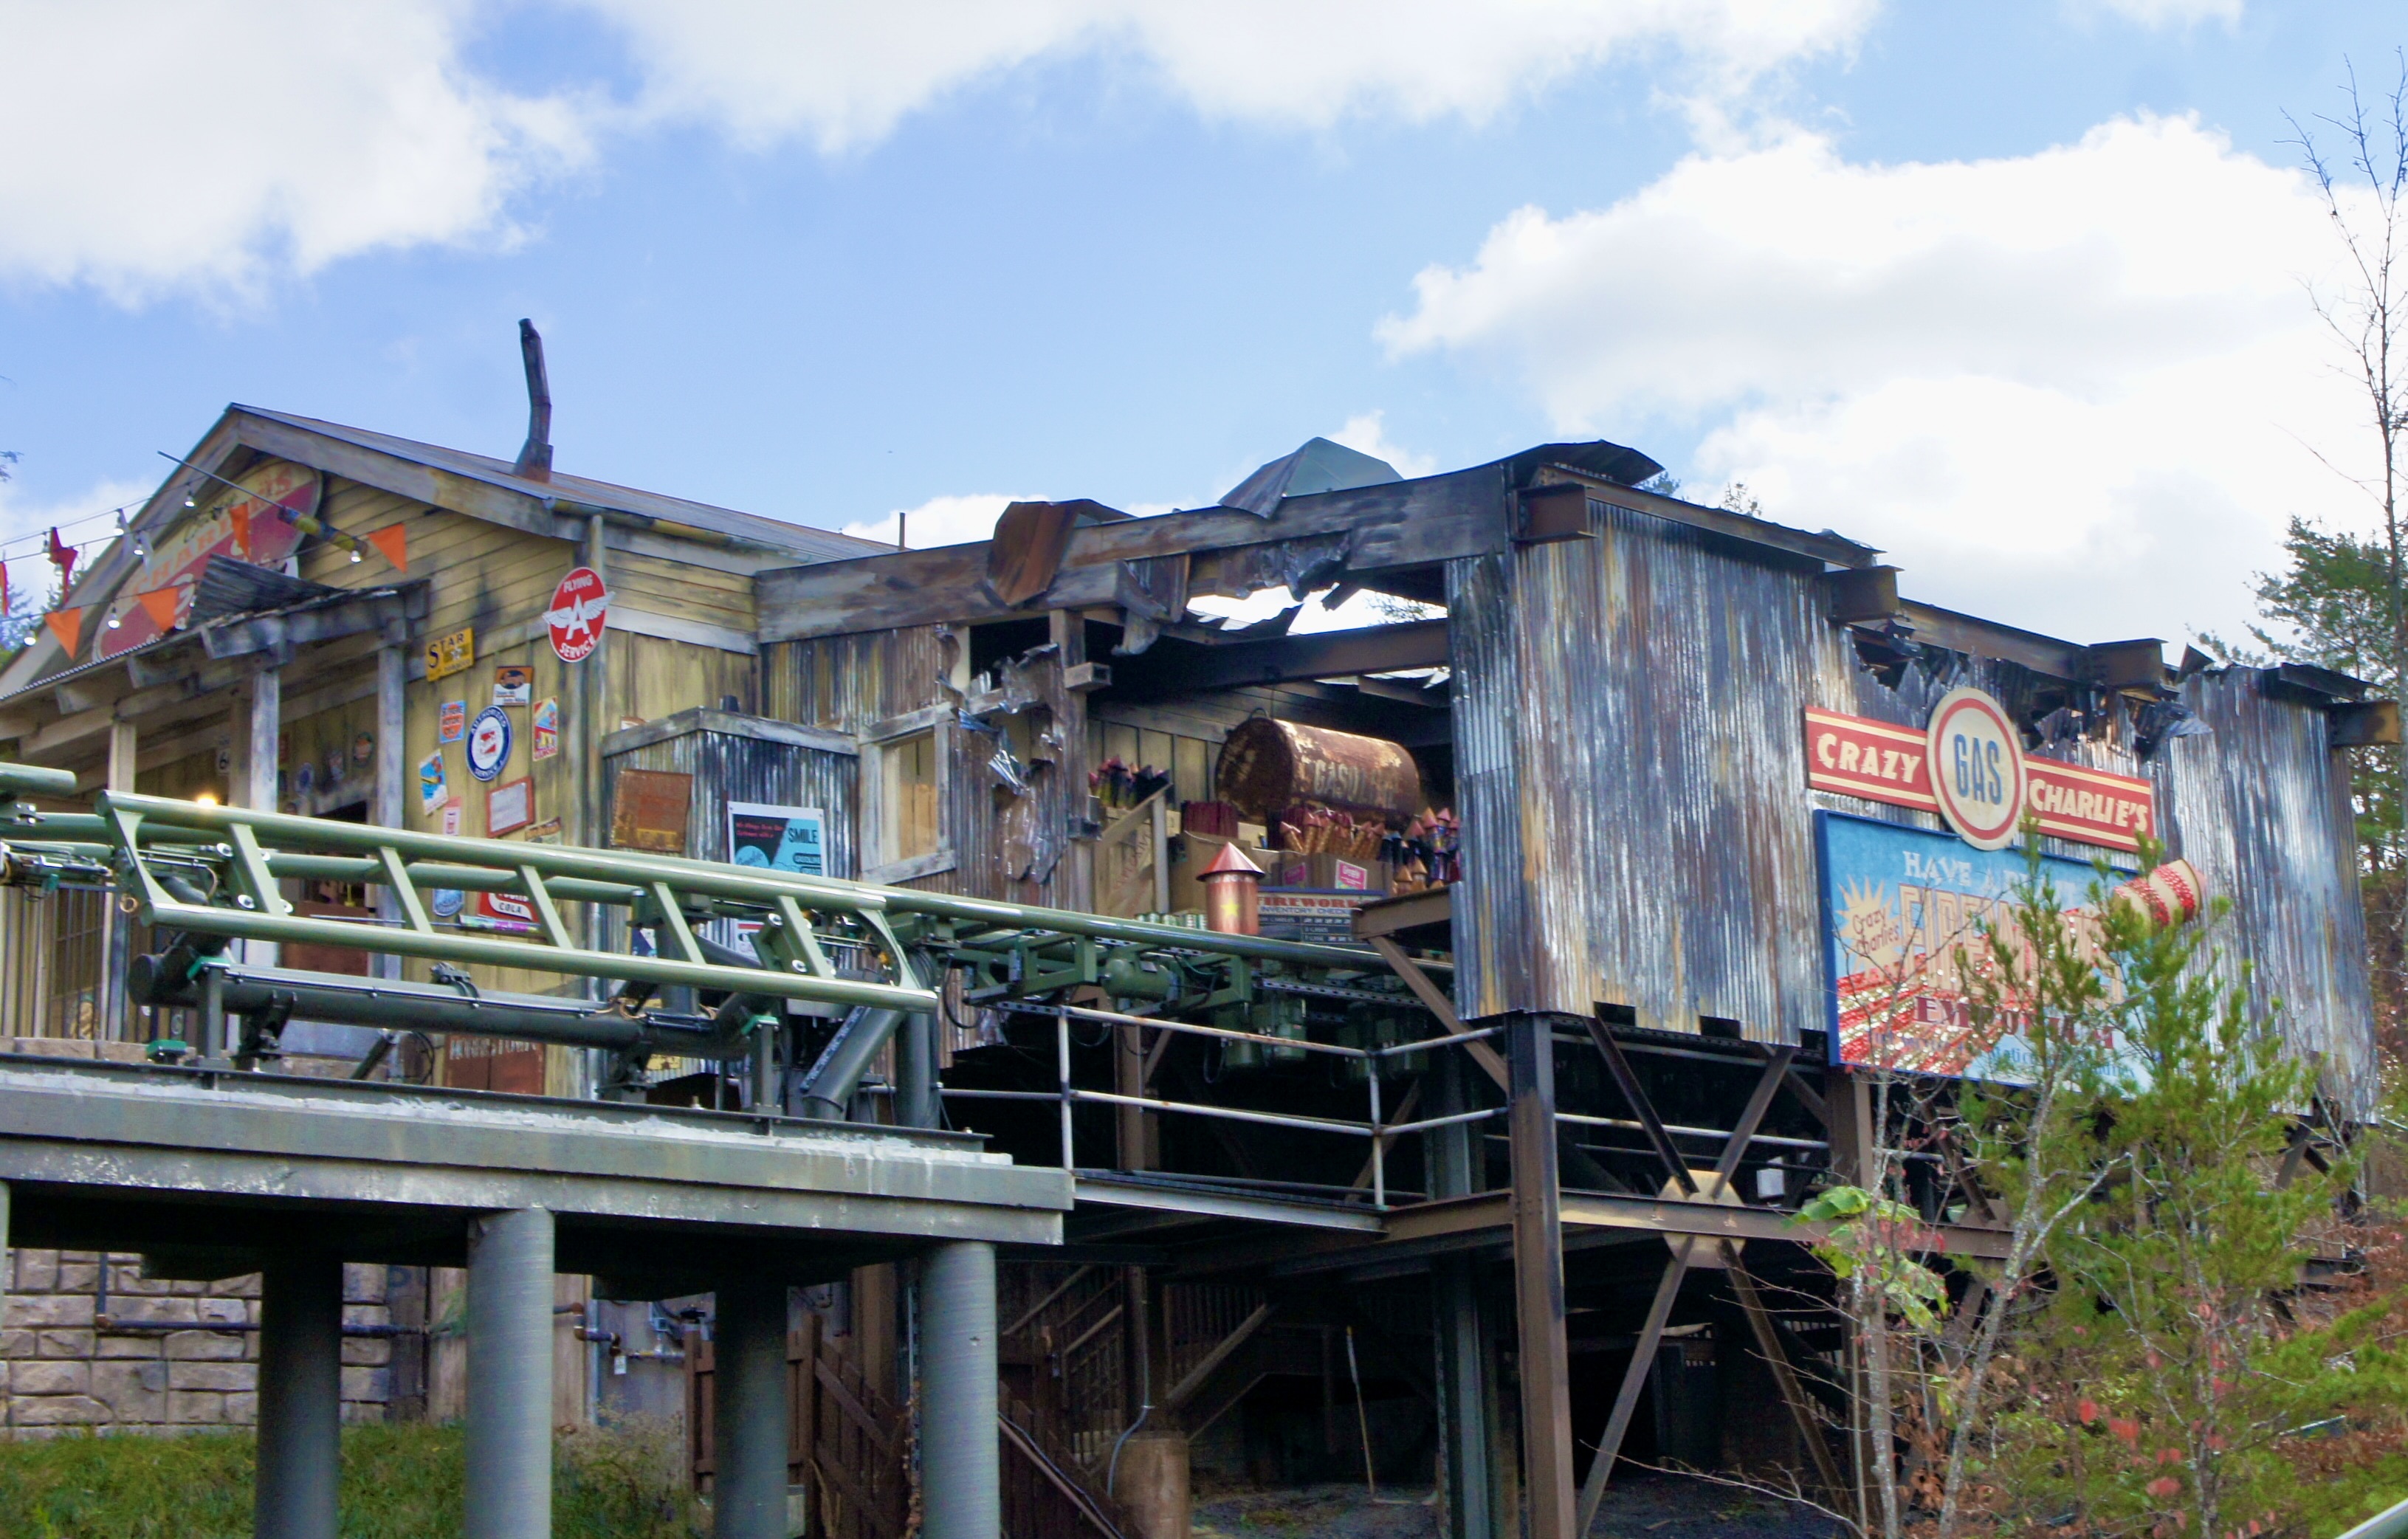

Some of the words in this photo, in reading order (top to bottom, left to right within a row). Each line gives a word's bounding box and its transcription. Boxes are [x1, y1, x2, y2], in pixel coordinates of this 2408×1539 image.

[563, 574, 593, 593] FLYING
[428, 633, 464, 668] STAR
[1817, 732, 1921, 783] CRAZY
[1954, 734, 2002, 805] GAS
[2029, 779, 2148, 832] CHARLIE'S
[788, 827, 819, 844] SMILE
[1902, 850, 1972, 886] HAVE
[499, 902, 522, 913] COLA
[1852, 907, 1887, 934] Crazy
